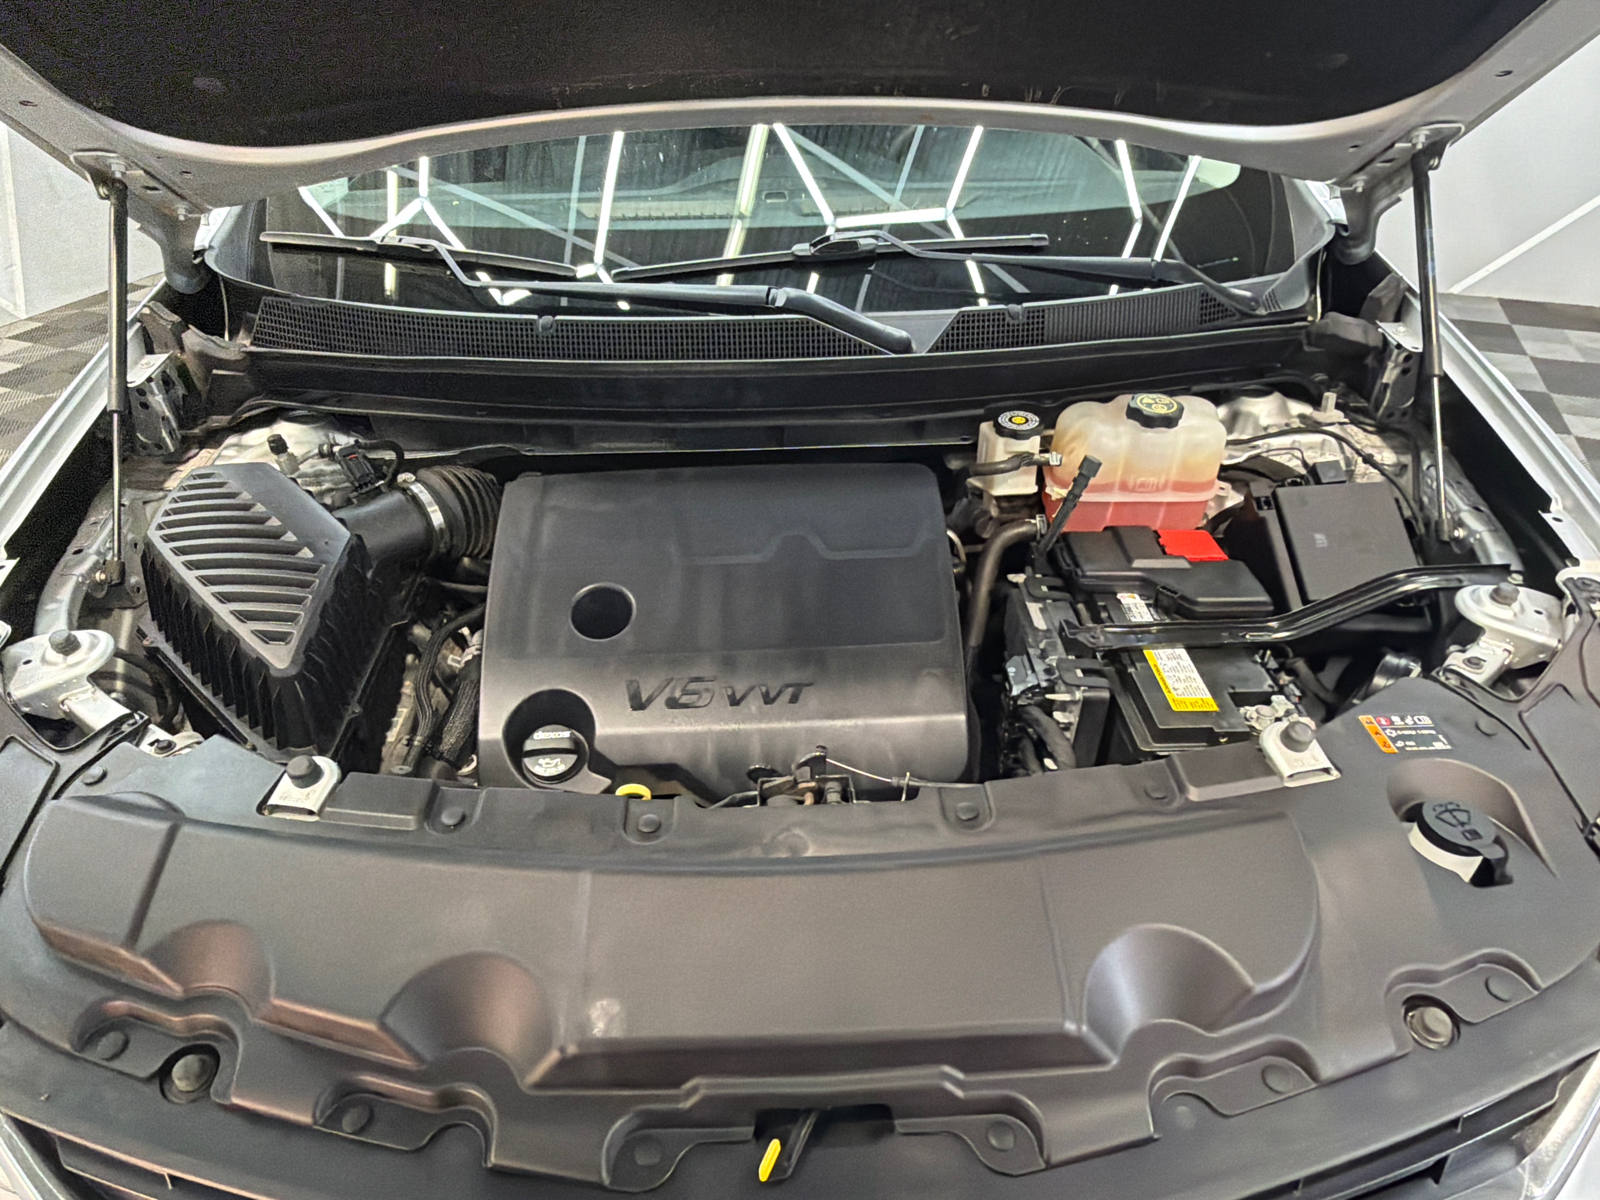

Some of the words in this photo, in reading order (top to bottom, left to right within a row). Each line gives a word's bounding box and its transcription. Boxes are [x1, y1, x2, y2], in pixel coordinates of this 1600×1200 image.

[625, 676, 717, 711] V6
[723, 681, 815, 707] VVT
[533, 730, 572, 740] dexos
